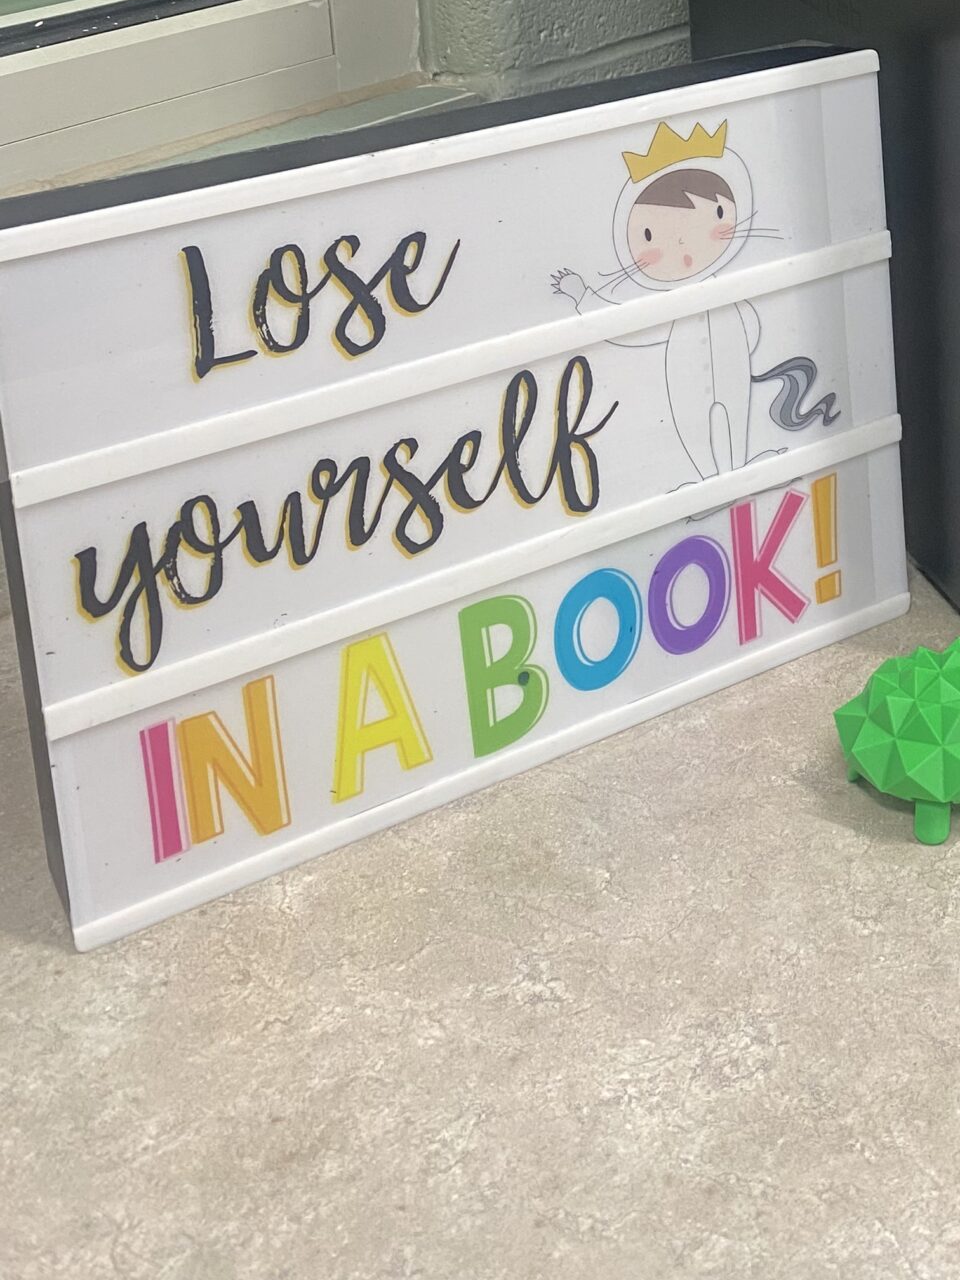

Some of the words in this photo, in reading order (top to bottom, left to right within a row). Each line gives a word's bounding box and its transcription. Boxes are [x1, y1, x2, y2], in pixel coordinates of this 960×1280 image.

[180, 230, 461, 383] Lose
[71, 355, 619, 675] yourself
[139, 675, 293, 865] IN
[332, 632, 434, 805] A
[456, 472, 841, 760] BOOK!
